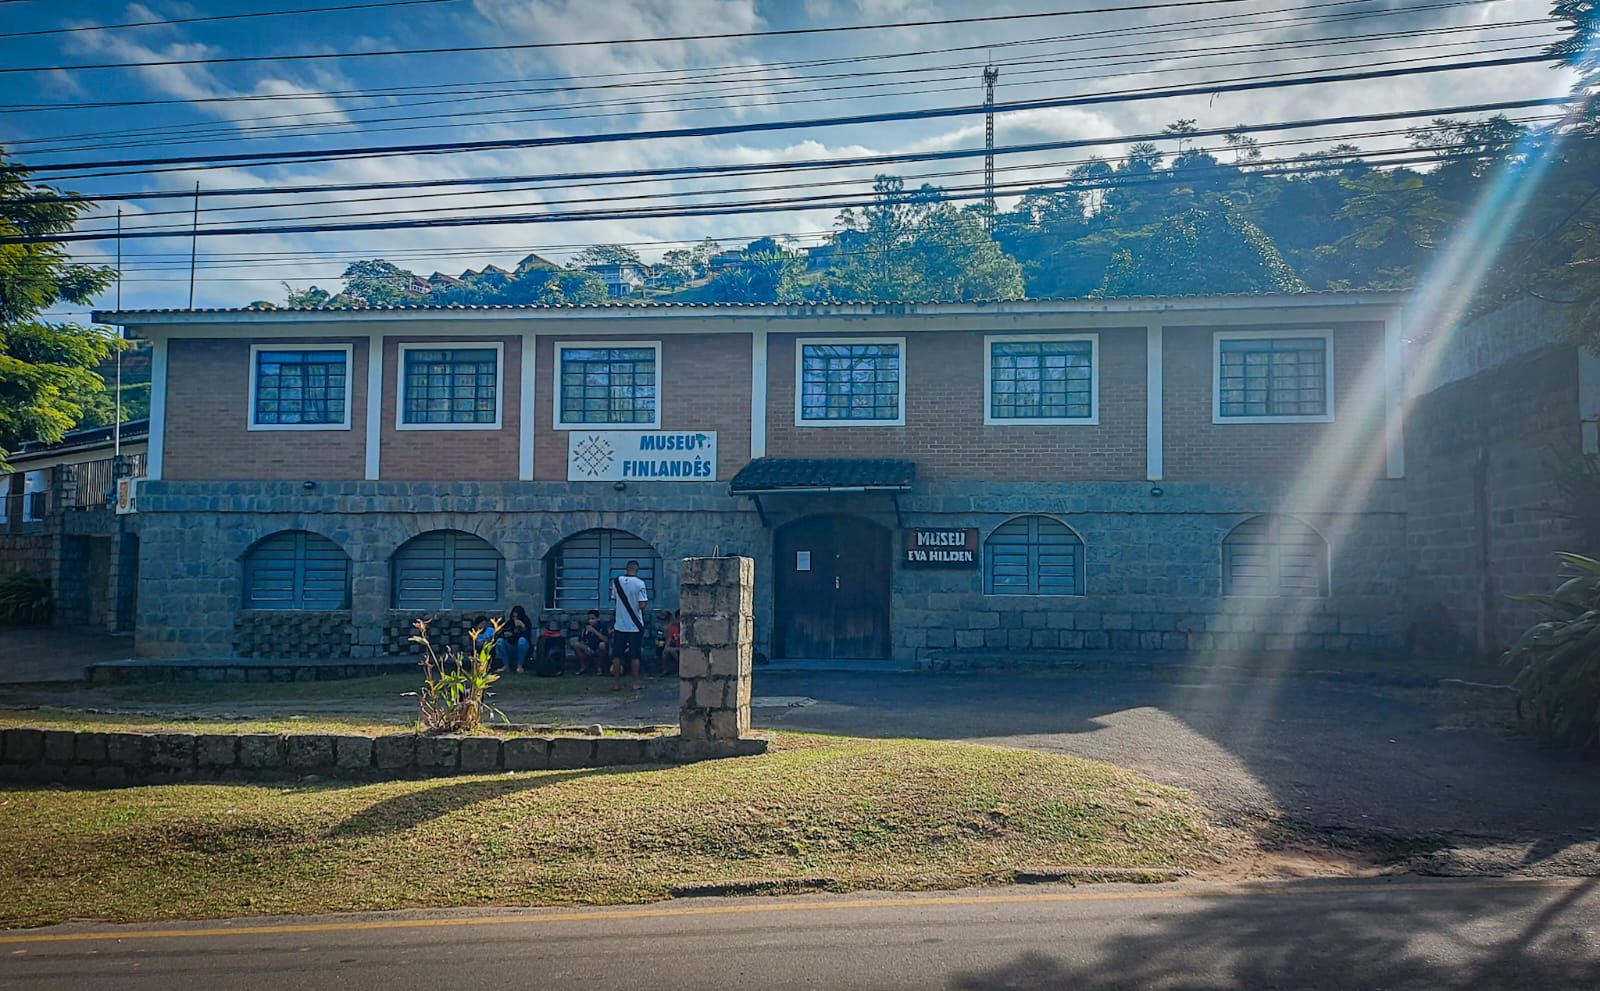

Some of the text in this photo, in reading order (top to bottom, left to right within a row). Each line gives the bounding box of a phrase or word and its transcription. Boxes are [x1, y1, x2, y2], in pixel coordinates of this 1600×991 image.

[640, 435, 696, 450] MUSEU
[623, 456, 711, 477] FINLANDÊS
[917, 532, 965, 546] MUSEU
[908, 550, 973, 562] EVA HILDEN
